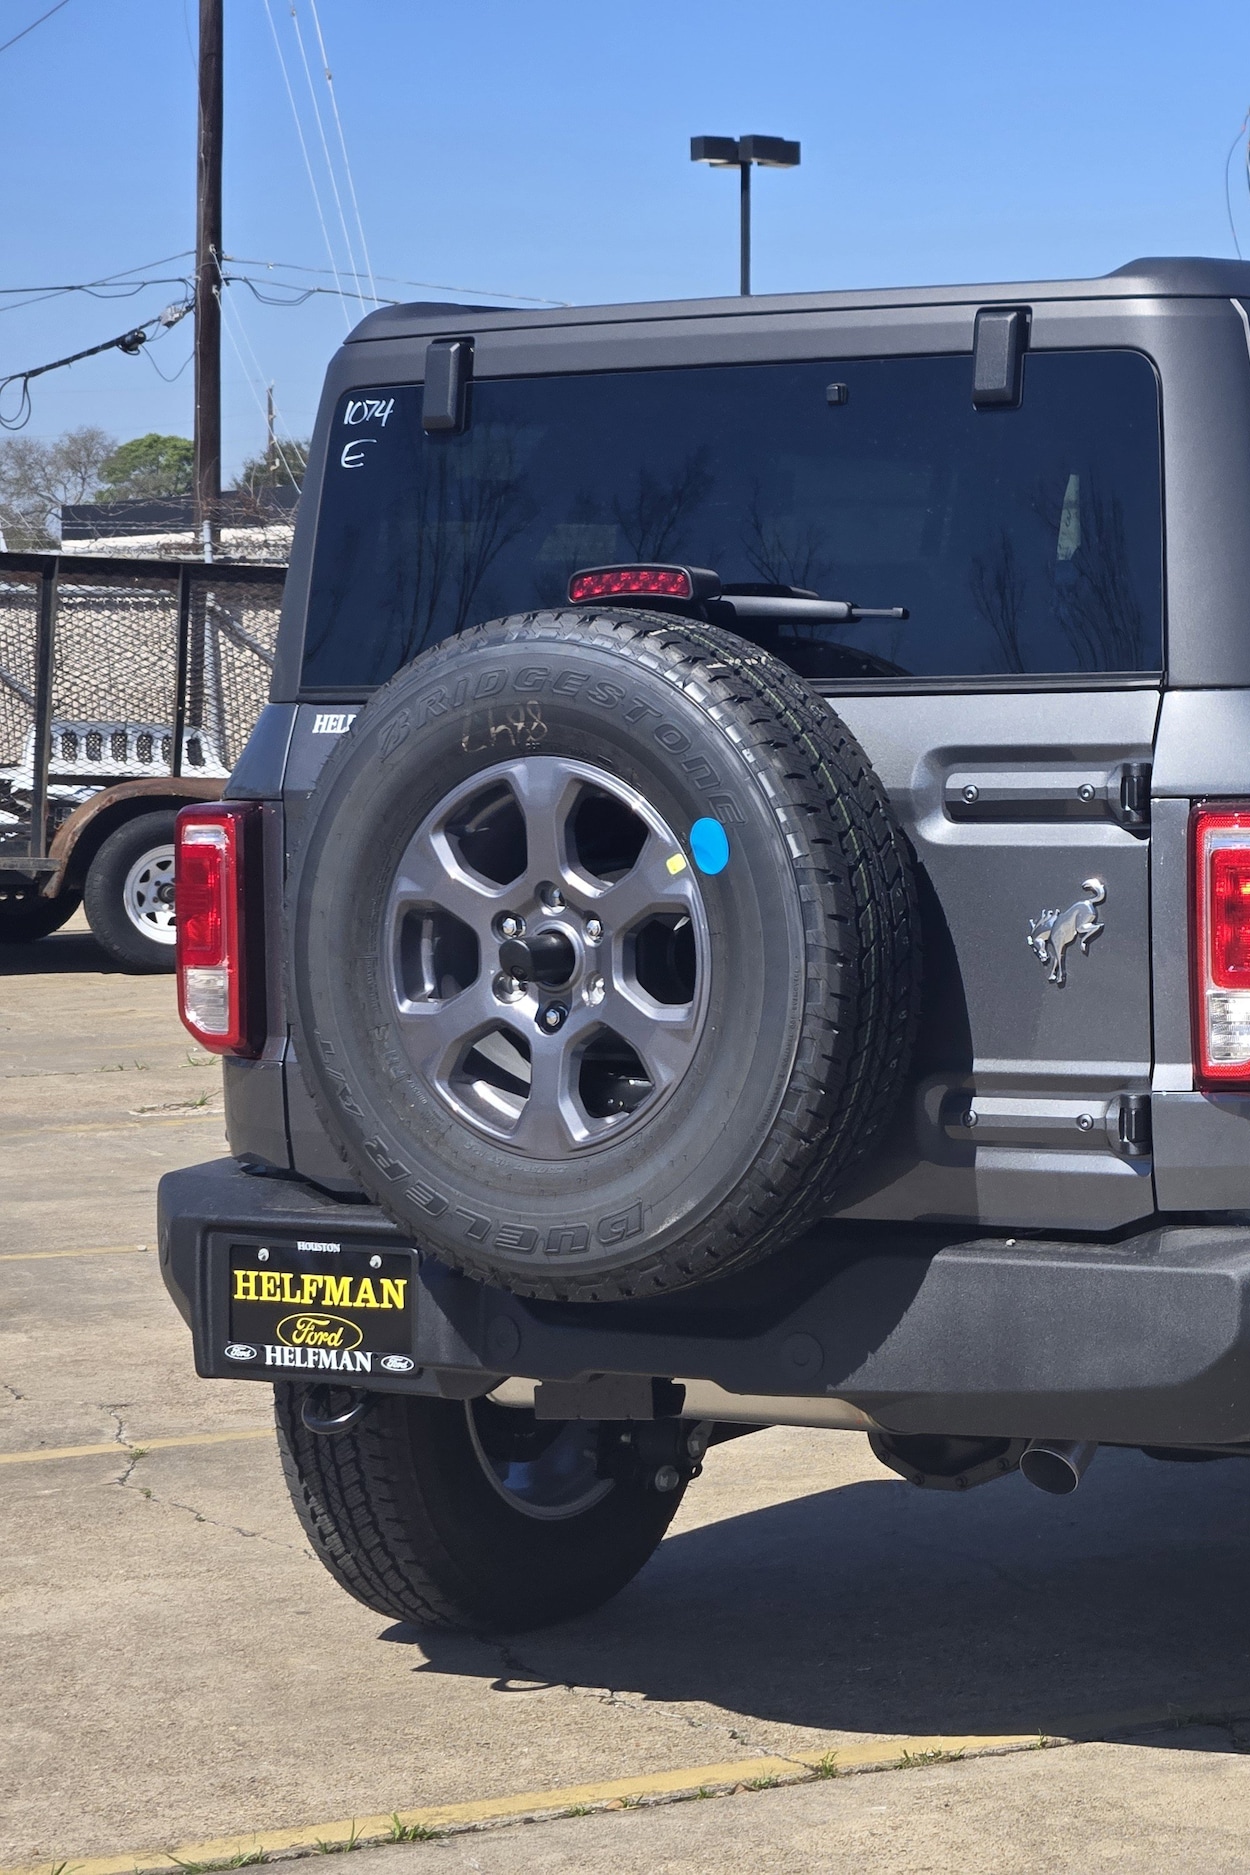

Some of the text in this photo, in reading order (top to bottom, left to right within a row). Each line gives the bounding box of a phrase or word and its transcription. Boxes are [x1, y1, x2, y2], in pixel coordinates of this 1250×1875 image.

[343, 398, 395, 427] 1074
[341, 439, 377, 468] E
[376, 664, 748, 826] BRIDGESTONE
[364, 1134, 646, 1256] DUELER
[297, 1241, 341, 1252] HOUSTON
[233, 1270, 408, 1309] HELFMAN
[291, 1317, 345, 1346] Ford
[264, 1344, 372, 1373] HELFMAN
